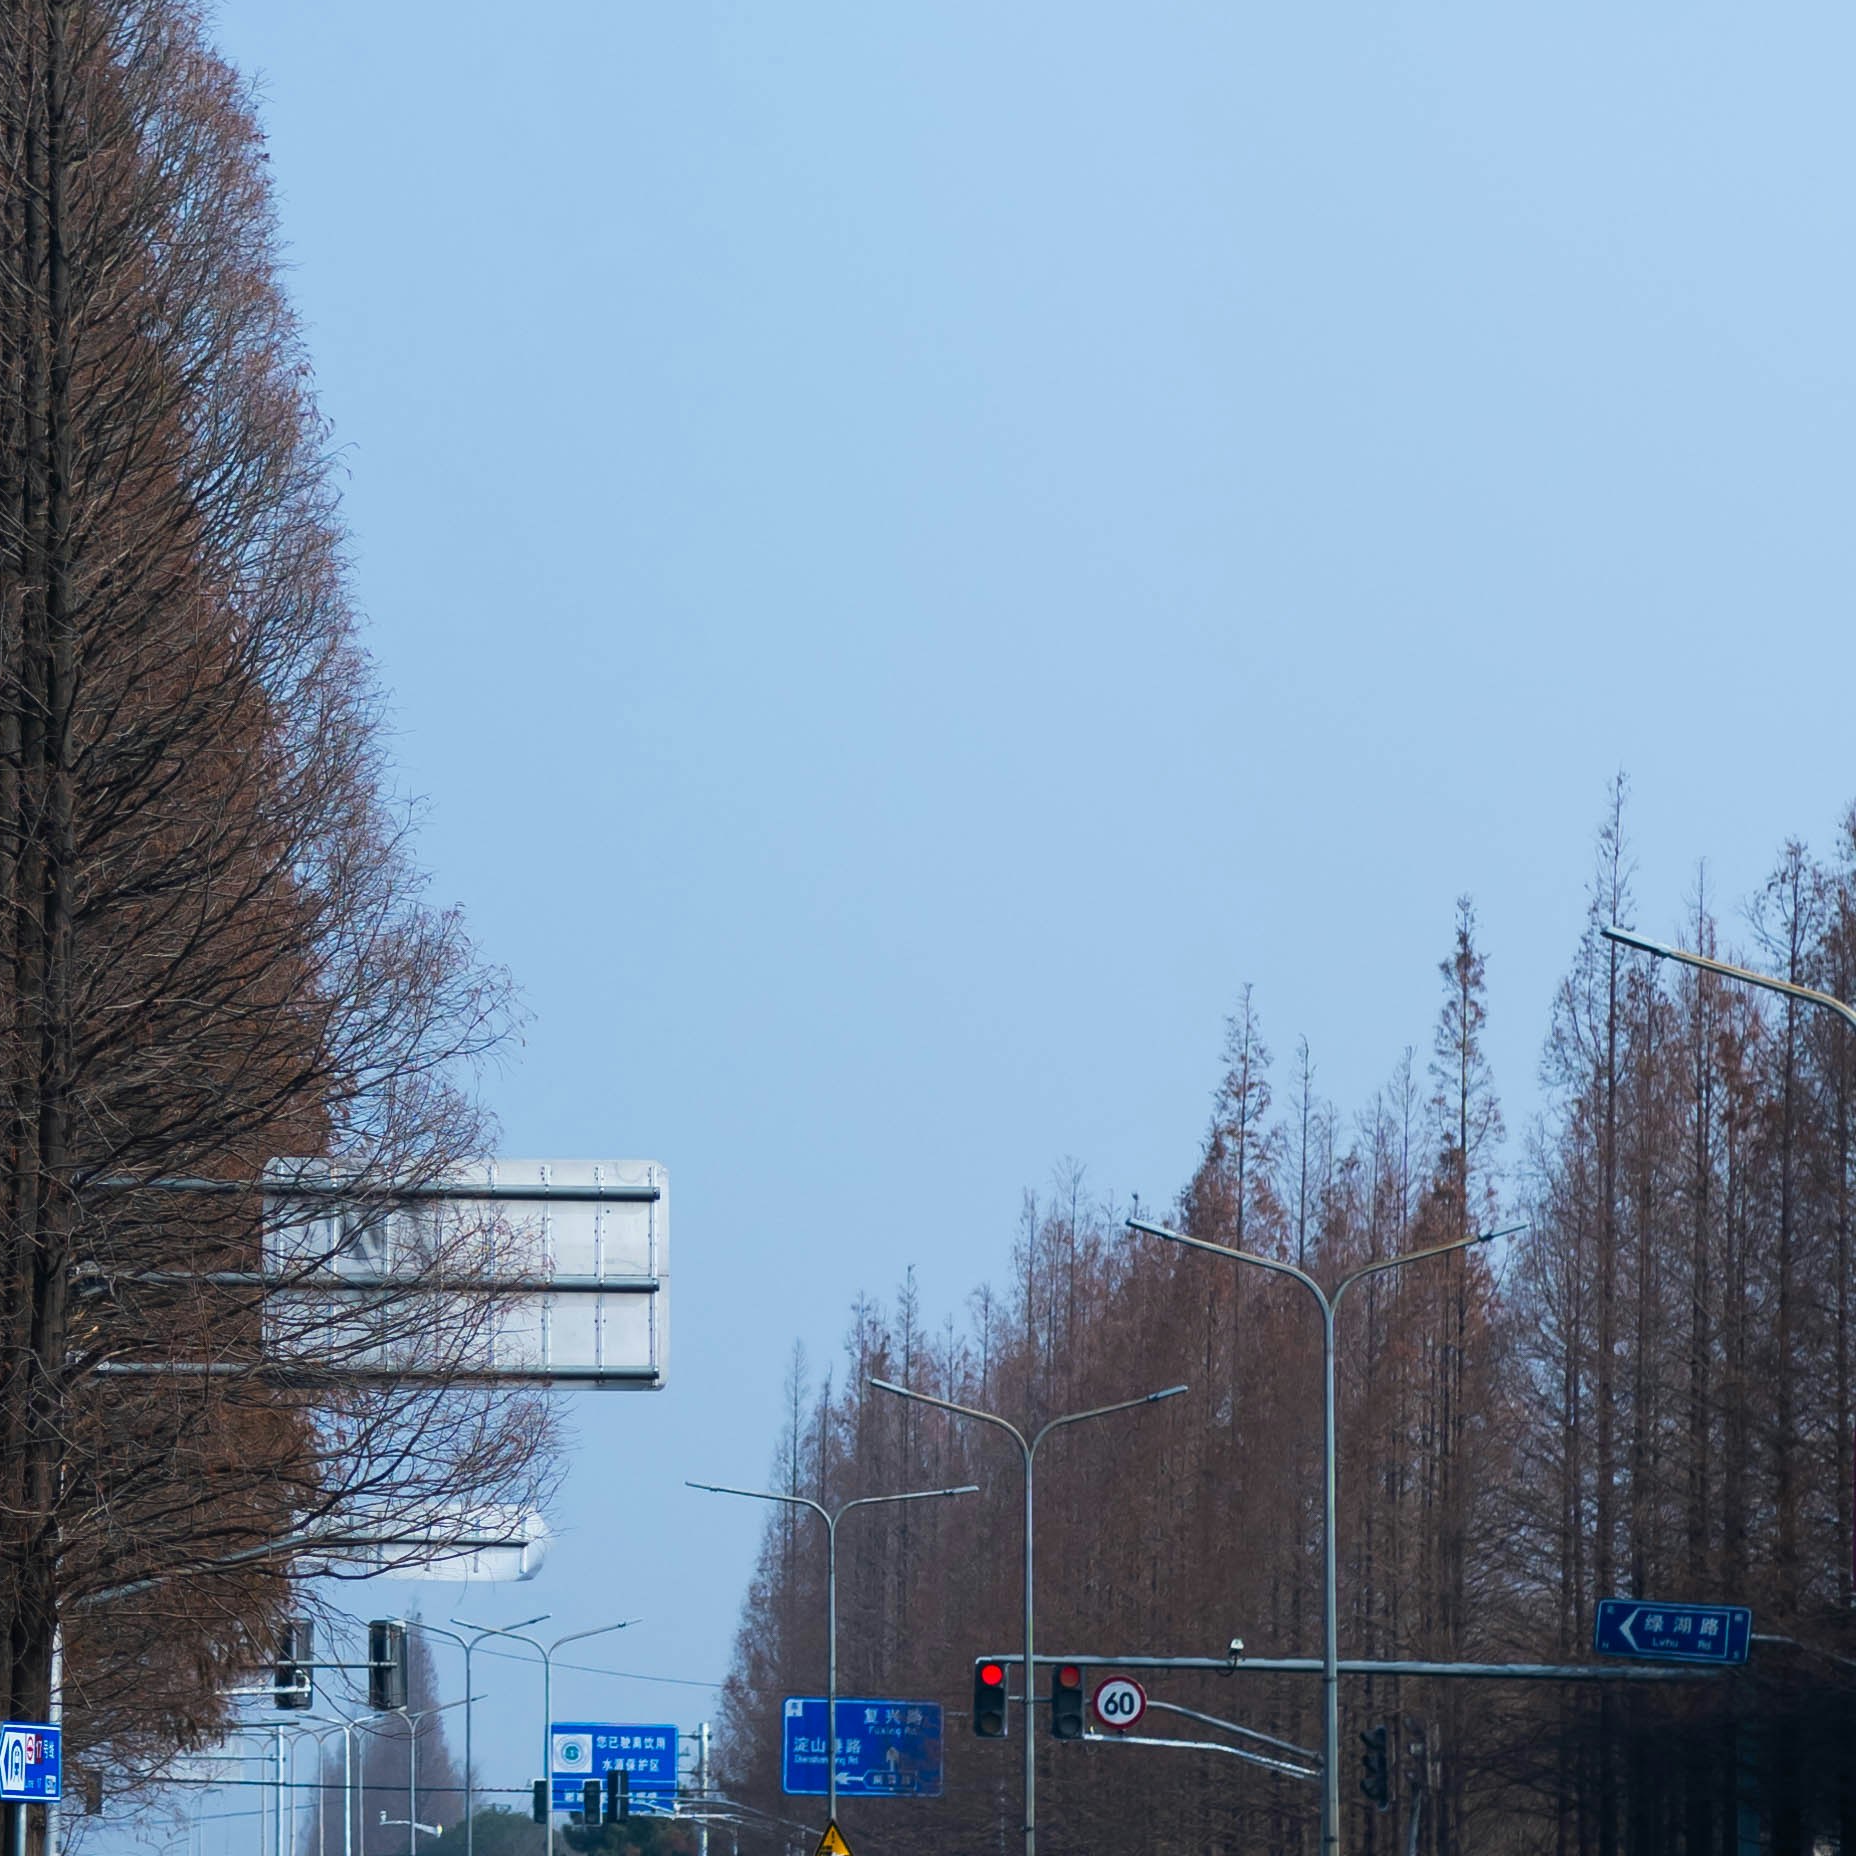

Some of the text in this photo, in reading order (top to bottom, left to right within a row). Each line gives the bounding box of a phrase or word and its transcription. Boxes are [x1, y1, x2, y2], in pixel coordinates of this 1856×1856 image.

[1644, 1613, 1719, 1636] 绿湖路
[1104, 1692, 1134, 1716] 60
[864, 1707, 923, 1725] 复兴路
[602, 1758, 660, 1772] 水源保护区
